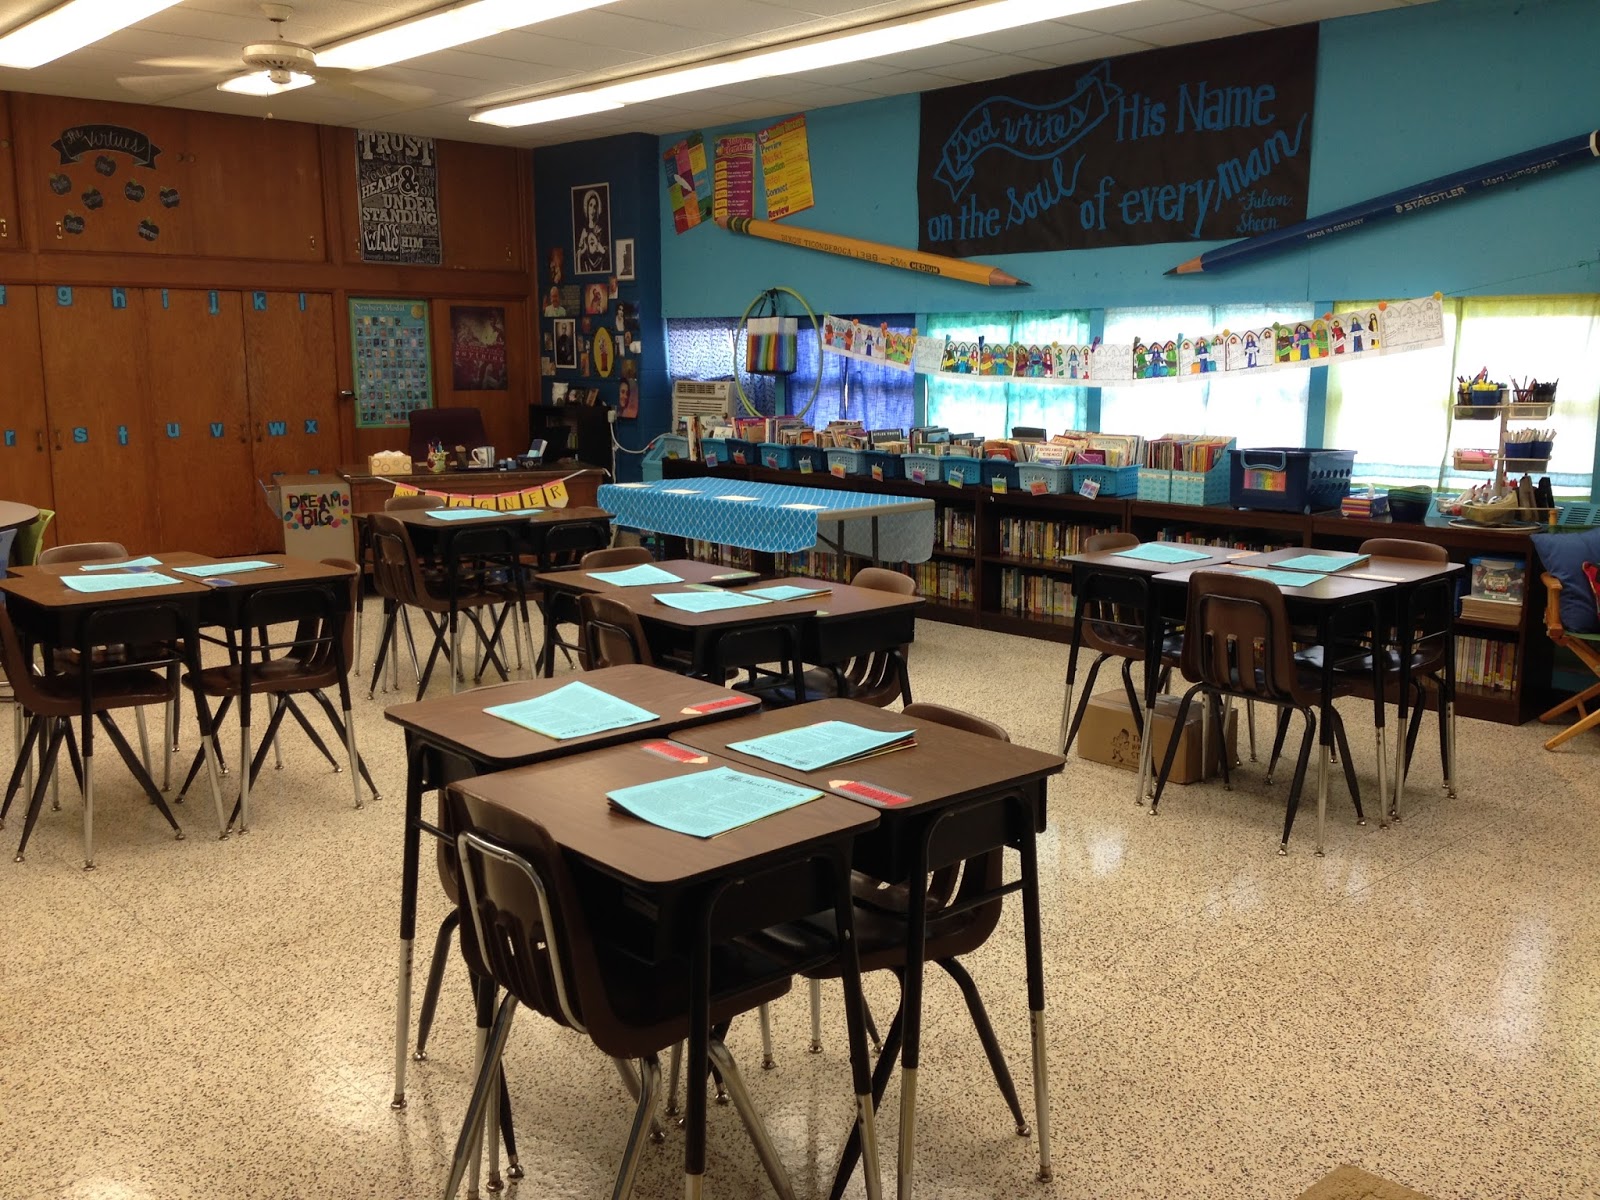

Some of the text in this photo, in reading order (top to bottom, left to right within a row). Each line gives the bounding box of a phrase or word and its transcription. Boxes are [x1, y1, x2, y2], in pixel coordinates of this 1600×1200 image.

[1116, 81, 1277, 143] His Name
[83, 131, 145, 153] Virtues
[951, 93, 1093, 171] God writes
[358, 130, 433, 166] TRUST
[761, 141, 782, 155] Preview
[362, 172, 399, 199] HEART
[398, 165, 419, 197] &
[928, 112, 1308, 242] on the soul of every man
[1482, 161, 1560, 188] Mars Lumograph
[766, 183, 789, 198] Connect
[1404, 186, 1467, 212] STAEDTLER
[382, 194, 435, 212] UNDER
[768, 205, 790, 219] Review
[362, 207, 438, 226] STANDING
[1235, 213, 1278, 233] Sheen
[364, 223, 400, 252] WAYS
[1307, 218, 1365, 241] MADE IN GERMANY
[401, 236, 423, 248] HIM
[804, 239, 852, 257] TICONDEROGA
[856, 250, 878, 262] 1388
[911, 262, 939, 274] MEDIUM
[58, 286, 72, 305] g
[113, 289, 126, 308] h
[162, 289, 168, 308] i
[209, 291, 218, 314] j
[254, 292, 266, 310] k
[355, 303, 383, 312] Newbery
[6, 420, 317, 445] r s t u v w x
[288, 494, 341, 510] DREAM
[299, 508, 332, 527] BIG
